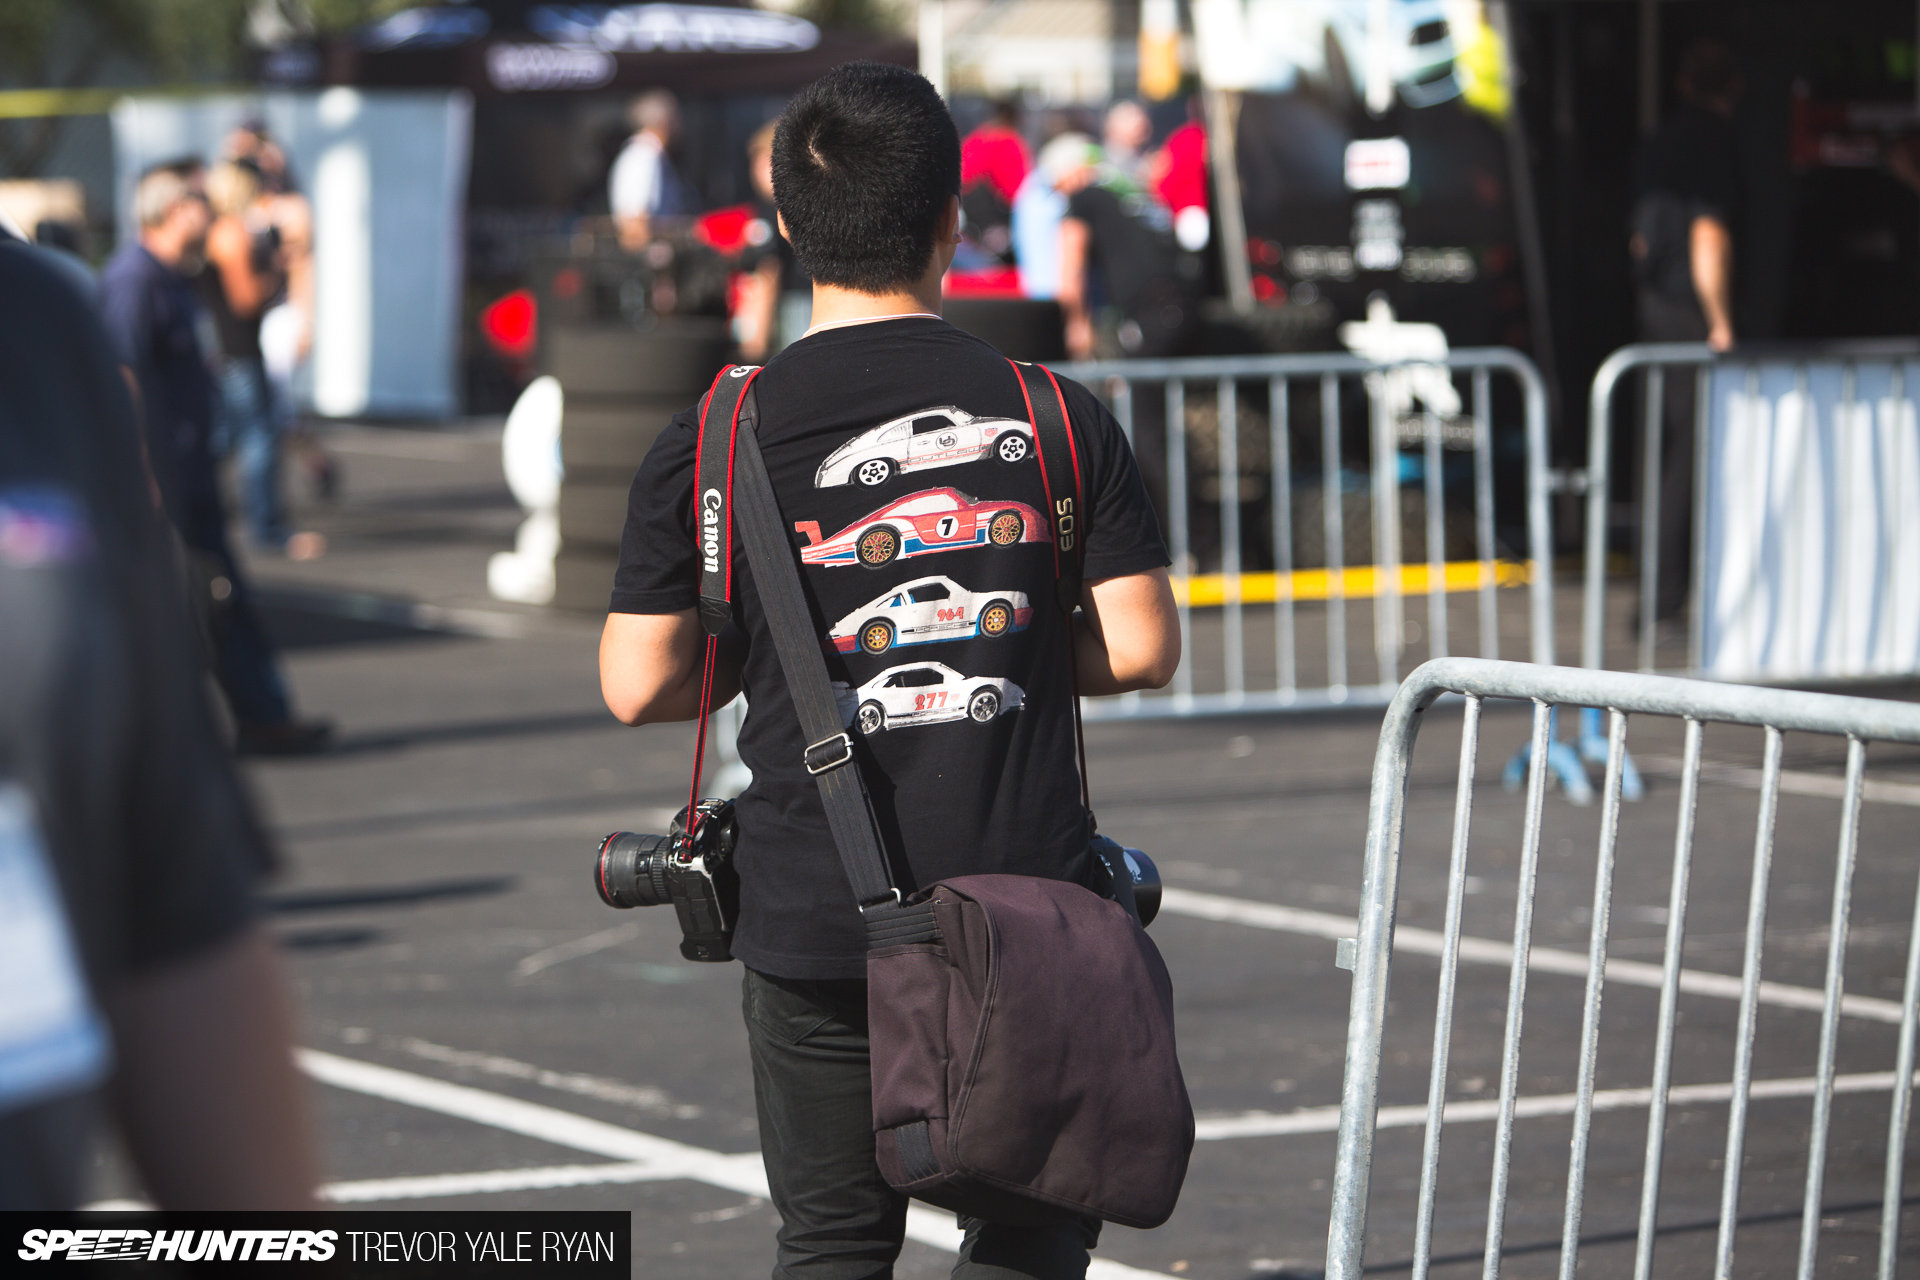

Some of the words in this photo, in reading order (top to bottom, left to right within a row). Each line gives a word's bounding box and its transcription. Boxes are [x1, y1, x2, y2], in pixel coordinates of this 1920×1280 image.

[703, 488, 722, 573] Canon
[941, 518, 954, 537] 7
[1057, 497, 1074, 552] EOS
[937, 606, 965, 622] 964
[914, 690, 949, 711] 277
